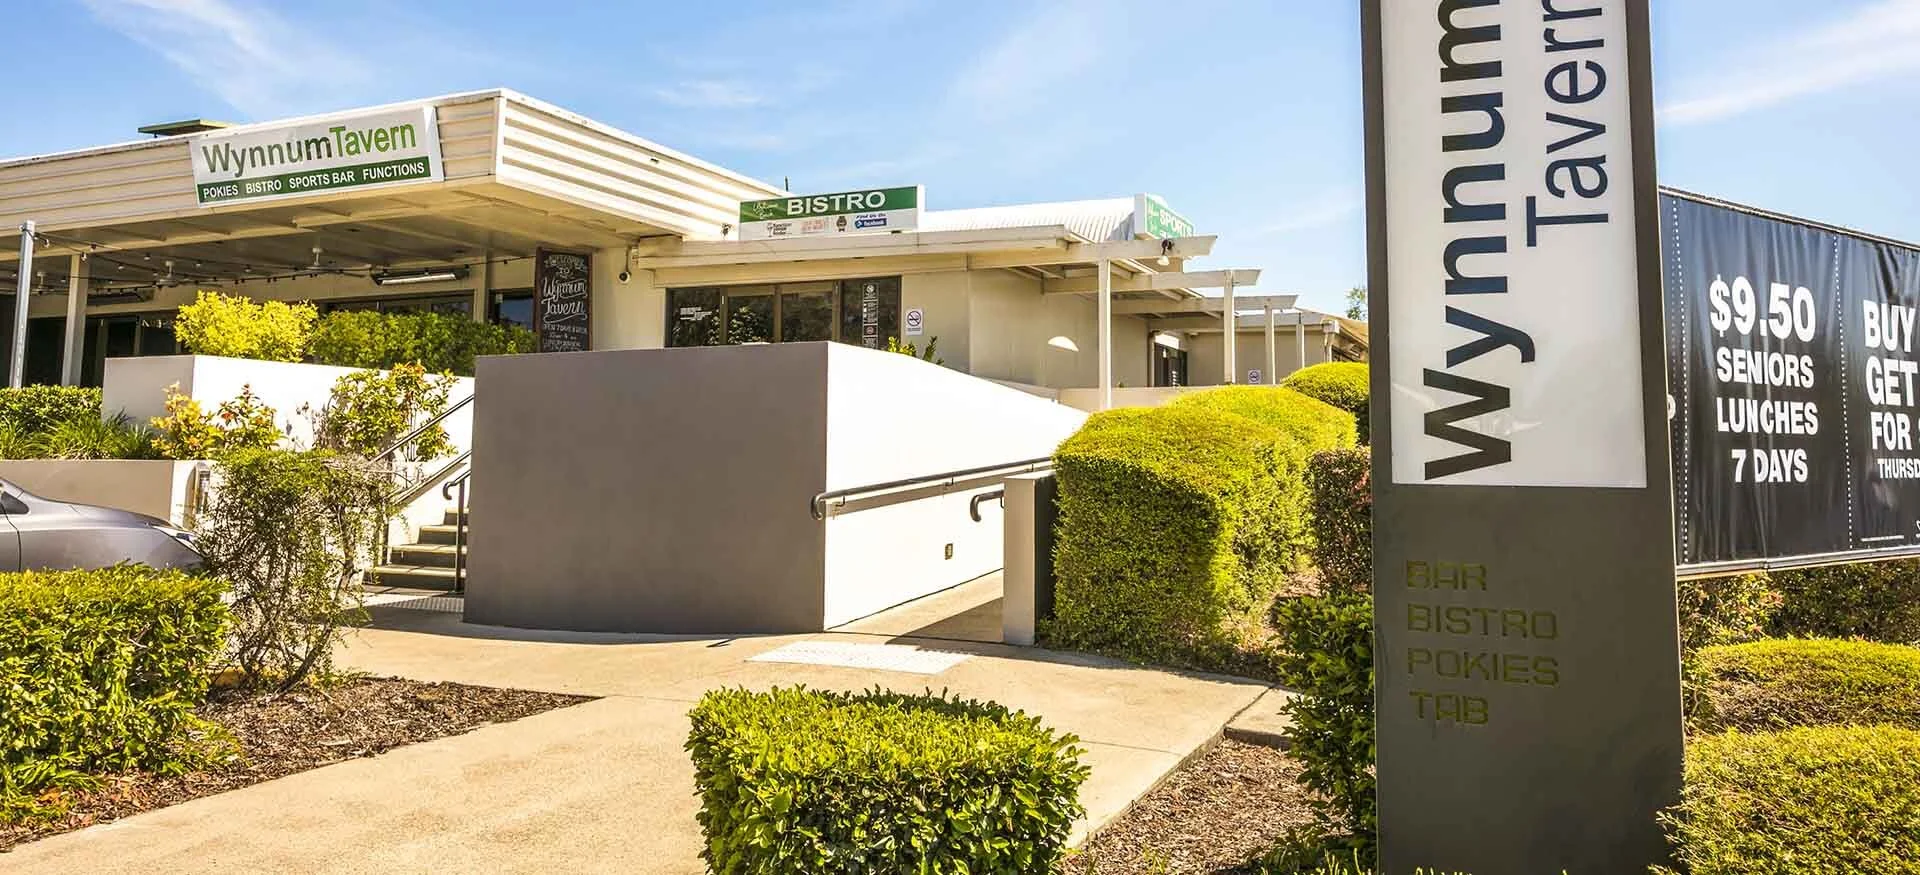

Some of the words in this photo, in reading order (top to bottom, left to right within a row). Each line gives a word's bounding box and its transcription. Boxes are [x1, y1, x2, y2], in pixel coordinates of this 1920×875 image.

[203, 184, 239, 199] POKIES
[246, 179, 282, 195] BISTRO
[289, 173, 330, 189] SPORTS
[332, 171, 355, 184] BAR
[363, 162, 425, 180] FUNCTIONS
[787, 191, 886, 216] BISTRO
[1423, 0, 1536, 481] Wynnum
[1709, 274, 1817, 342] $9.50
[1863, 300, 1916, 353] BUY
[1716, 347, 1814, 388] SENIORS
[1865, 356, 1919, 407] GET
[1716, 397, 1819, 435] LUNCHES
[1870, 411, 1913, 451] FOR
[1731, 449, 1747, 483] 7
[1754, 449, 1808, 483] DAYS
[1406, 560, 1487, 591] BAR
[1407, 603, 1559, 639] BISTRO
[1407, 648, 1560, 686] POKIES
[1409, 689, 1489, 725] TAB
